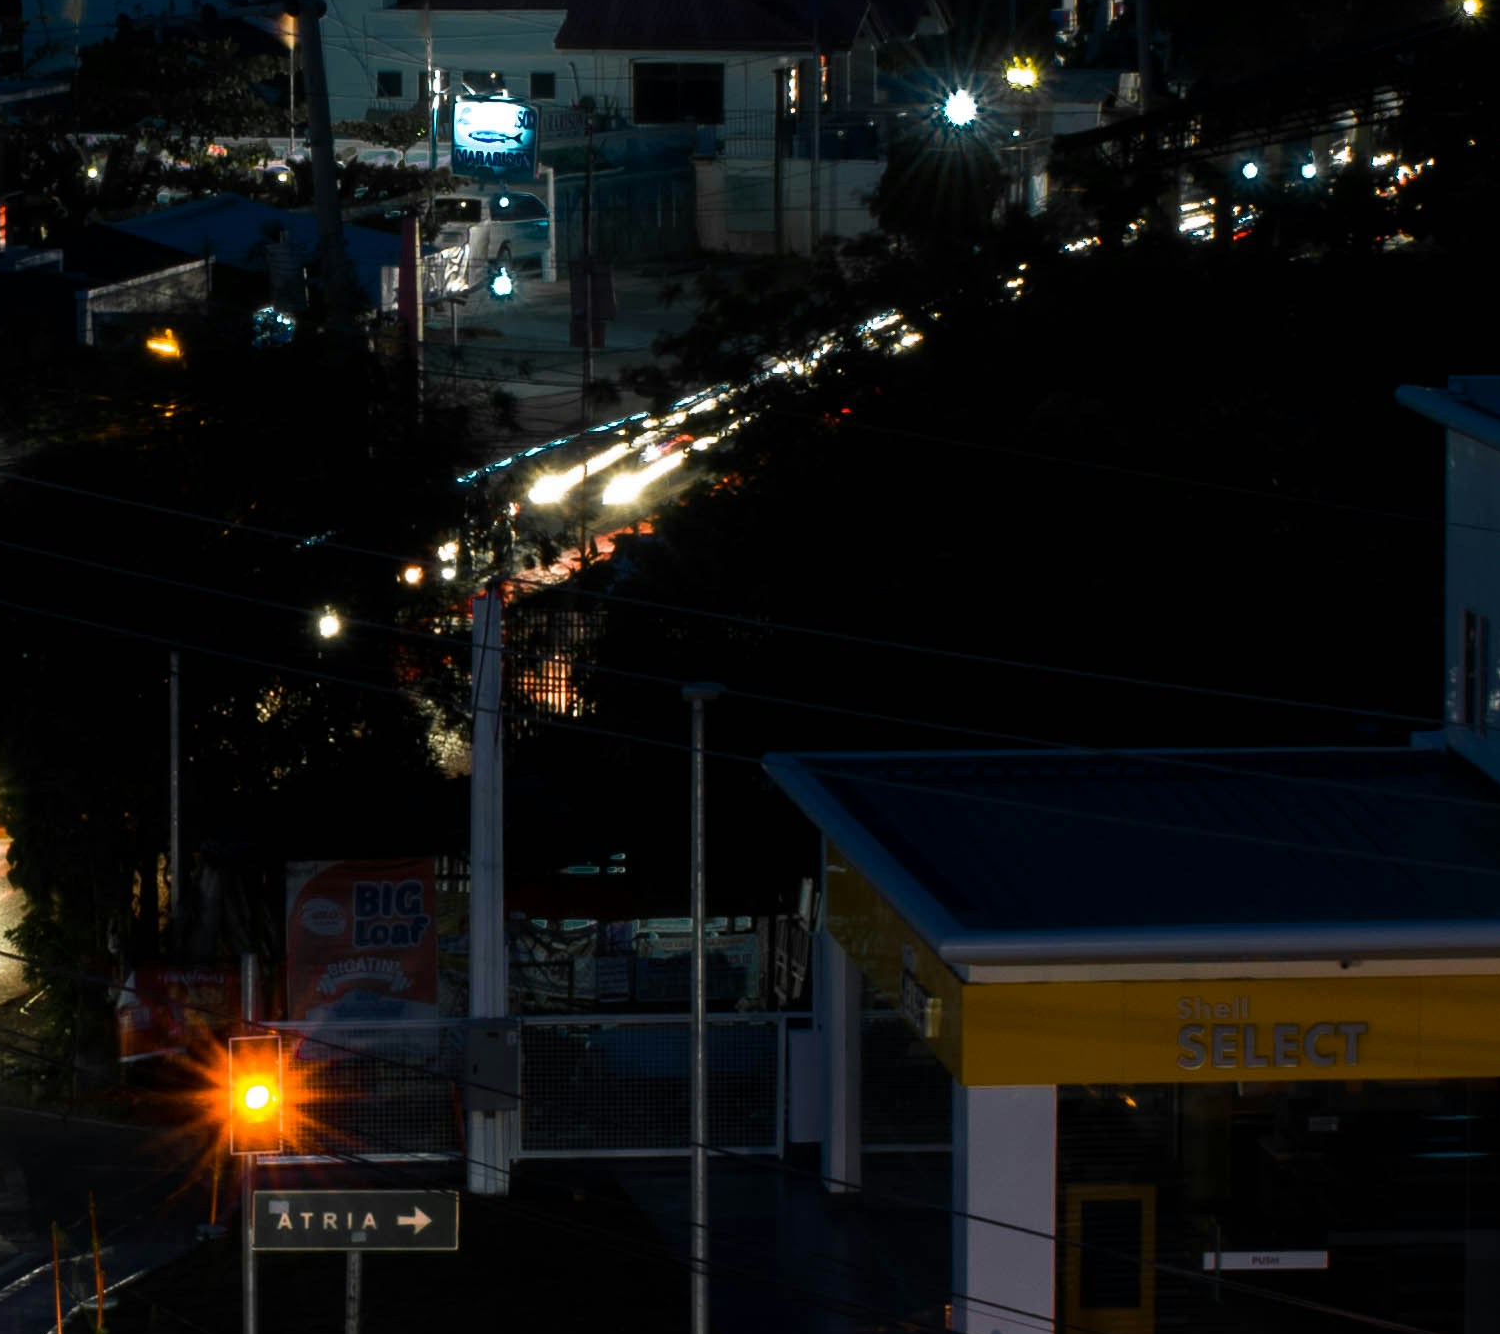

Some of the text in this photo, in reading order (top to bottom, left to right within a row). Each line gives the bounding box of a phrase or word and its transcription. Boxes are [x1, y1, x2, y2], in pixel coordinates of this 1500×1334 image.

[355, 880, 423, 917] BIG
[355, 916, 430, 947] Loaf
[1176, 995, 1249, 1020] Shell
[1177, 1023, 1368, 1070] SELECT
[276, 1211, 378, 1230] ATRIA
